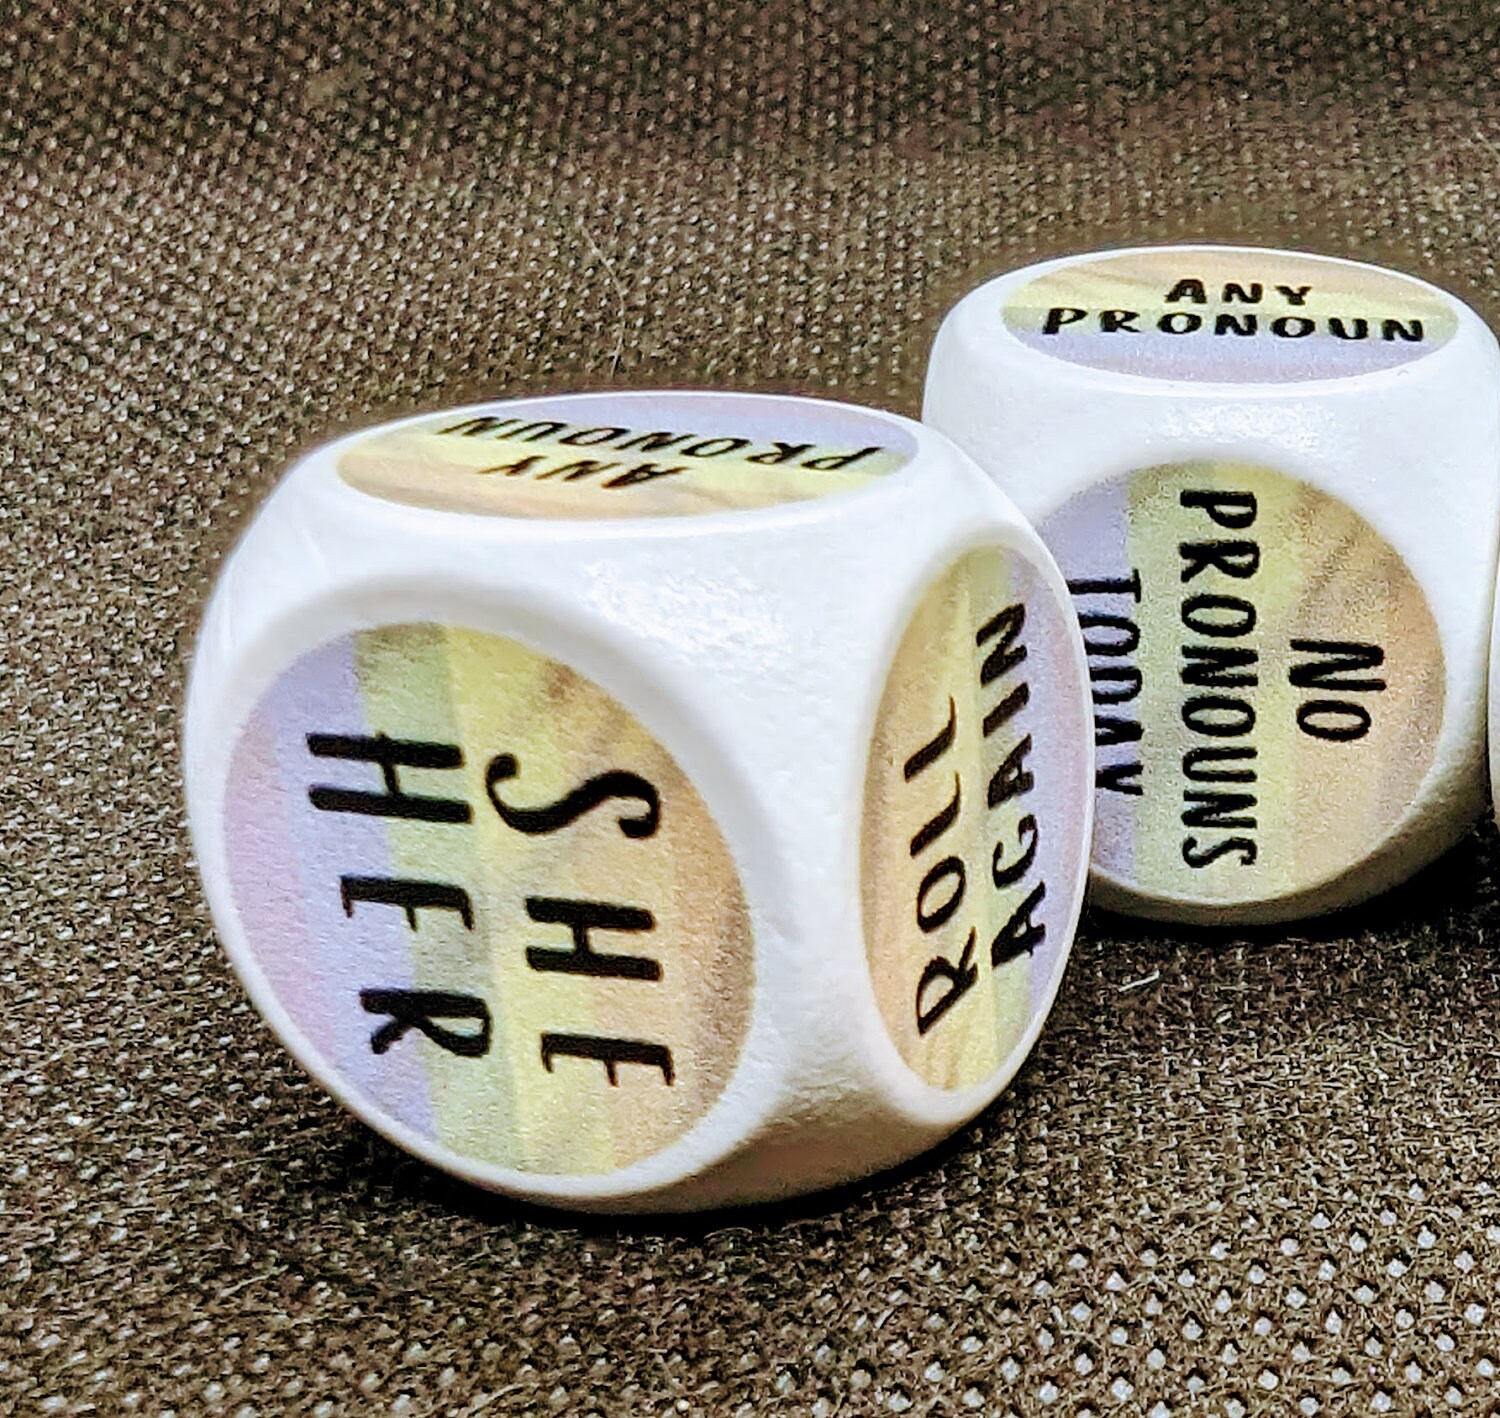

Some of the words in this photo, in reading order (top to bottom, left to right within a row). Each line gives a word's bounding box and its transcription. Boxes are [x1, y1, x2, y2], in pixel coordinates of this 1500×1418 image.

[1041, 306, 1425, 343] PRONOUN
[1164, 277, 1312, 306] ANY
[436, 415, 882, 473] PRONOUN
[476, 454, 684, 490] ANY
[974, 602, 1047, 970] AGAIN
[1178, 489, 1261, 869] PRONOUNS
[1287, 638, 1388, 744] NO
[305, 731, 494, 1060] HER
[484, 752, 676, 1087] SHE
[902, 696, 979, 1036] ROLL
